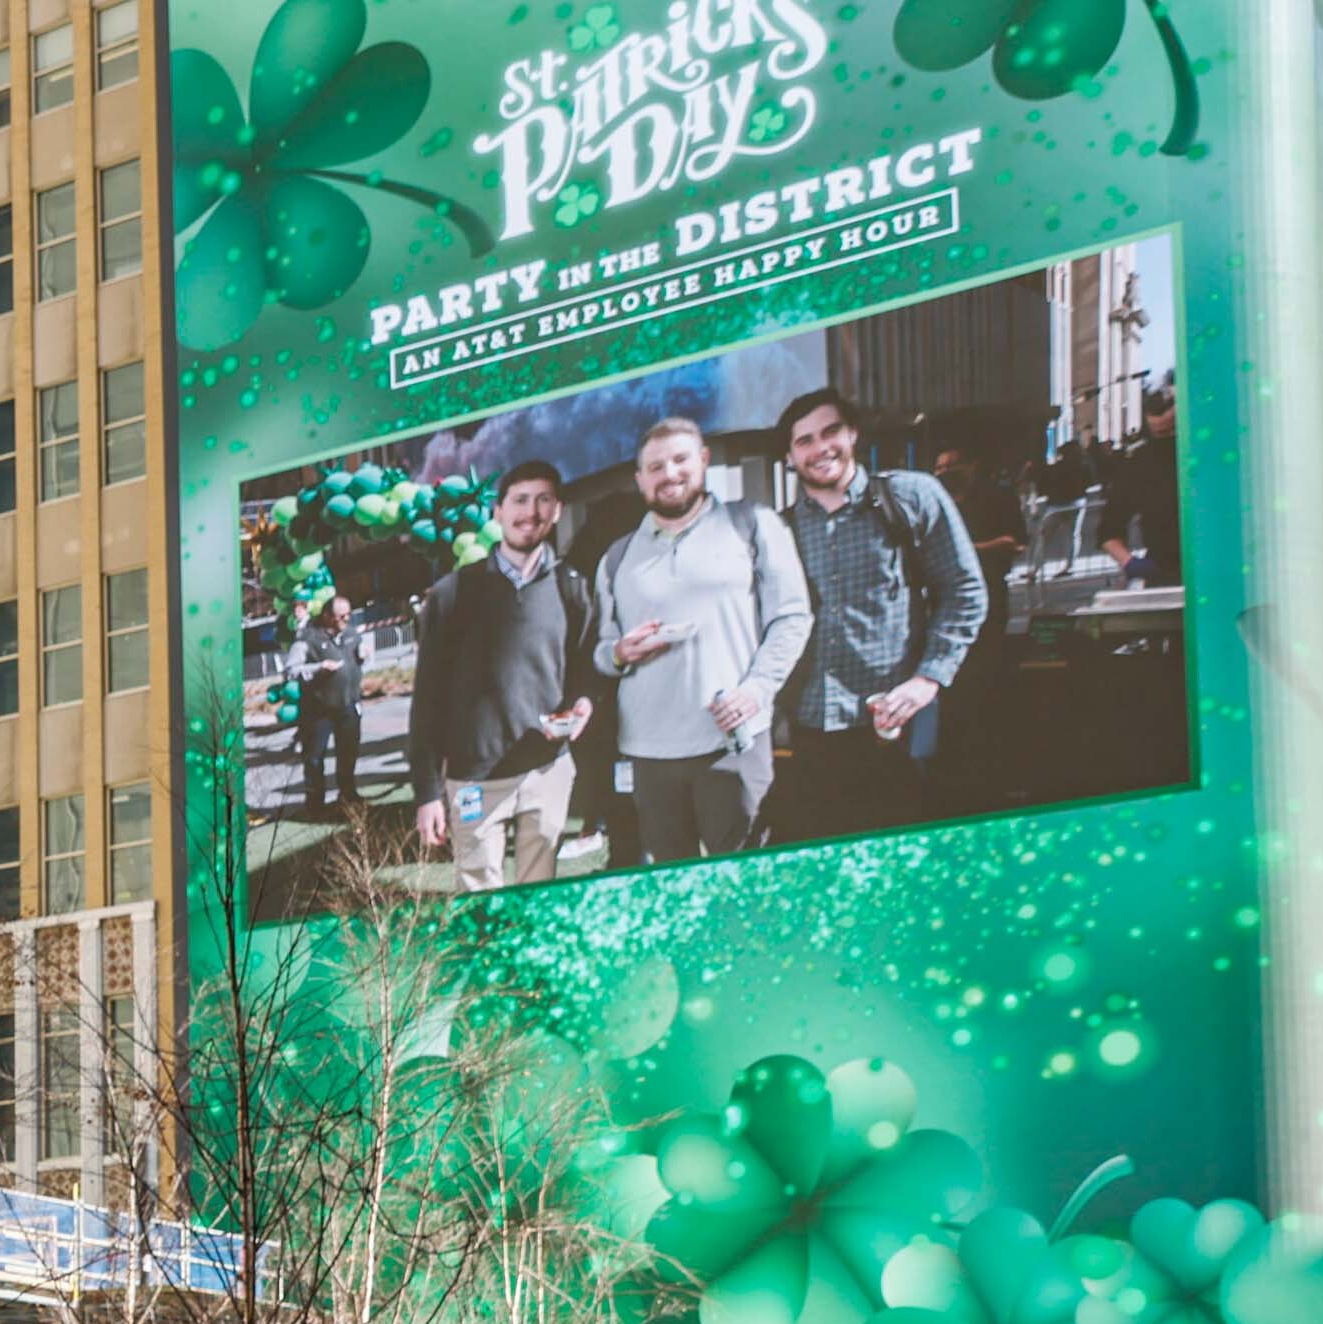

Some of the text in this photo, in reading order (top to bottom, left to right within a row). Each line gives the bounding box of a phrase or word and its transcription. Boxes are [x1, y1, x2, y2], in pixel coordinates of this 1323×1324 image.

[498, 49, 570, 120] St.
[369, 127, 982, 345] PARTY IN THE DISTRICT
[402, 205, 941, 374] AN AT&T EMPLOYEE HAPPY HOUR
